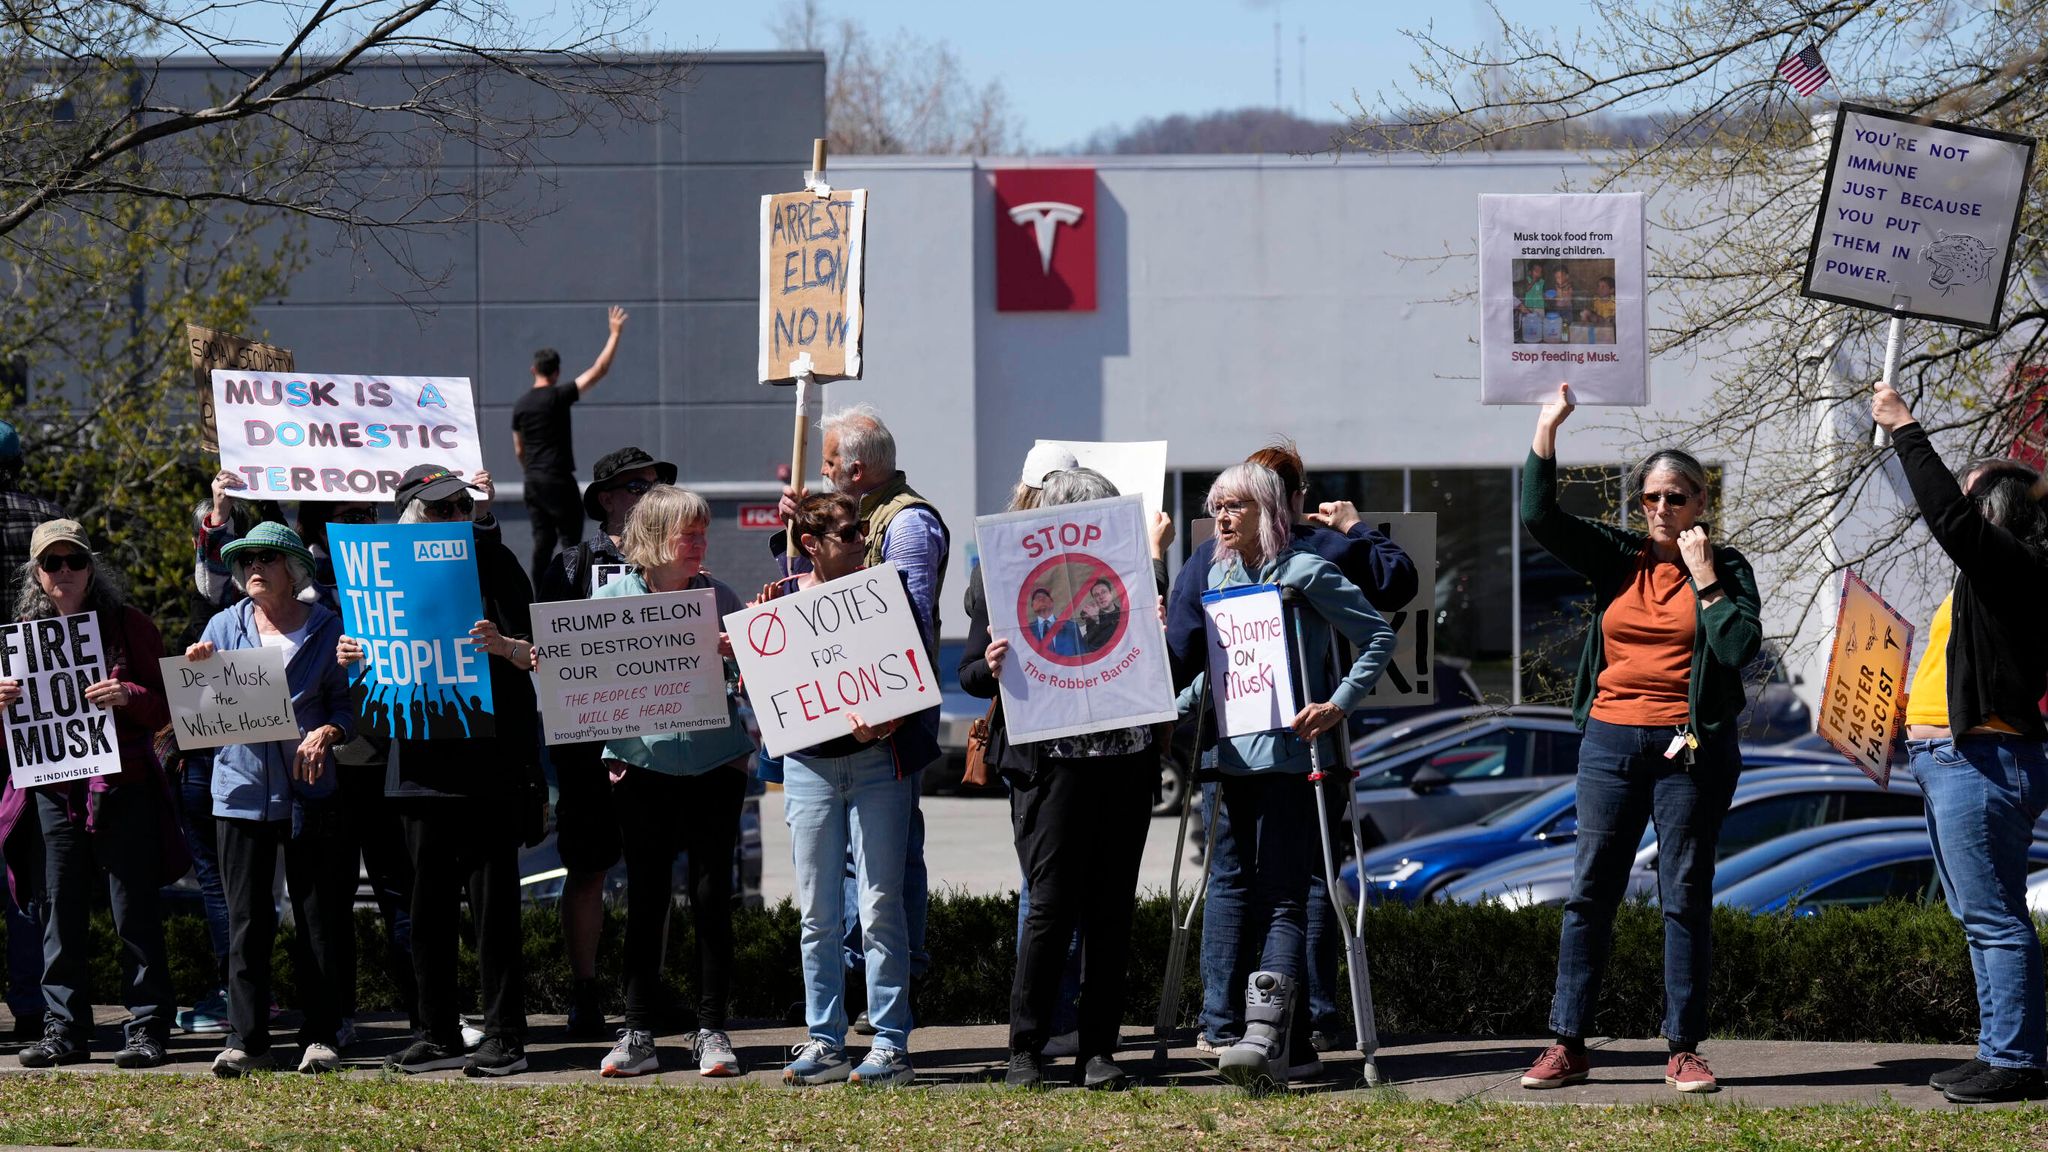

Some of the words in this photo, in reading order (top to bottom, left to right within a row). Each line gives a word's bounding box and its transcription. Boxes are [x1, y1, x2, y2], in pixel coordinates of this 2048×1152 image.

[1855, 129, 1918, 152] YOU'RE
[1929, 143, 1970, 162] NOT
[1847, 155, 1919, 180] IMMUNE
[1842, 181, 1888, 201] JUST
[1900, 192, 1982, 217] BECAUSE
[772, 200, 855, 246] ARREST
[1513, 232, 1539, 241] Musk
[1541, 232, 1563, 241] took
[1564, 232, 1587, 241] food
[1589, 232, 1613, 241] from
[1838, 208, 1874, 225] YOU
[1886, 216, 1921, 234] PUT
[1521, 246, 1561, 257] starving
[1562, 246, 1605, 255] children.
[1832, 233, 1881, 254] THEM
[1892, 245, 1911, 260] IN
[783, 239, 854, 296] ELON
[1825, 259, 1891, 283] POWER.
[774, 306, 851, 362] NOW
[192, 338, 238, 368] SOCIAL
[239, 347, 294, 372] SECURITY
[1511, 351, 1539, 364] Stop
[1541, 351, 1585, 364] feeding
[1587, 351, 1619, 362] Musk.
[225, 379, 340, 407] MUSK
[354, 382, 393, 407] IS
[417, 383, 447, 408] A
[244, 420, 458, 449] DOMESTIC
[418, 542, 463, 559] ACLU
[1022, 522, 1102, 559] STOP
[339, 541, 394, 587] WE
[346, 589, 408, 637] THE
[551, 612, 616, 633] tRUMP
[622, 609, 635, 625] &
[640, 602, 701, 623] fELON
[795, 579, 888, 636] VOTES
[0, 614, 98, 677] FIRE
[537, 644, 571, 659] ARE
[581, 632, 695, 656] DESTROYING
[1215, 612, 1281, 649] Shame
[355, 637, 478, 686] PEOPLE
[559, 665, 598, 680] OUR
[616, 656, 701, 677] COUNTRY
[811, 644, 848, 668] FOR
[1024, 661, 1047, 682] The
[1048, 675, 1098, 690] Robber
[1100, 646, 1141, 683] Barons
[1234, 648, 1255, 666] ON
[8, 667, 107, 725] ELON
[212, 692, 238, 705] the
[565, 693, 588, 708] THE
[592, 687, 648, 705] PEOPLES
[654, 681, 692, 697] VOICE
[770, 649, 926, 729] FELONS!
[1830, 674, 1851, 734] FAST
[181, 713, 237, 736] White
[239, 698, 290, 731] House!
[578, 711, 608, 724] WILL
[613, 708, 630, 721] BE
[639, 702, 682, 716] HEARD
[1848, 664, 1875, 750] FASTER
[1866, 667, 1894, 764] FASCIST
[12, 715, 112, 767] MUSK
[554, 728, 589, 740] brought
[591, 728, 609, 738] you
[612, 726, 623, 736] by
[625, 724, 640, 732] the
[654, 722, 667, 730] 1st
[670, 717, 726, 729] Amendment
[43, 766, 100, 782] INDIVISIBLE
